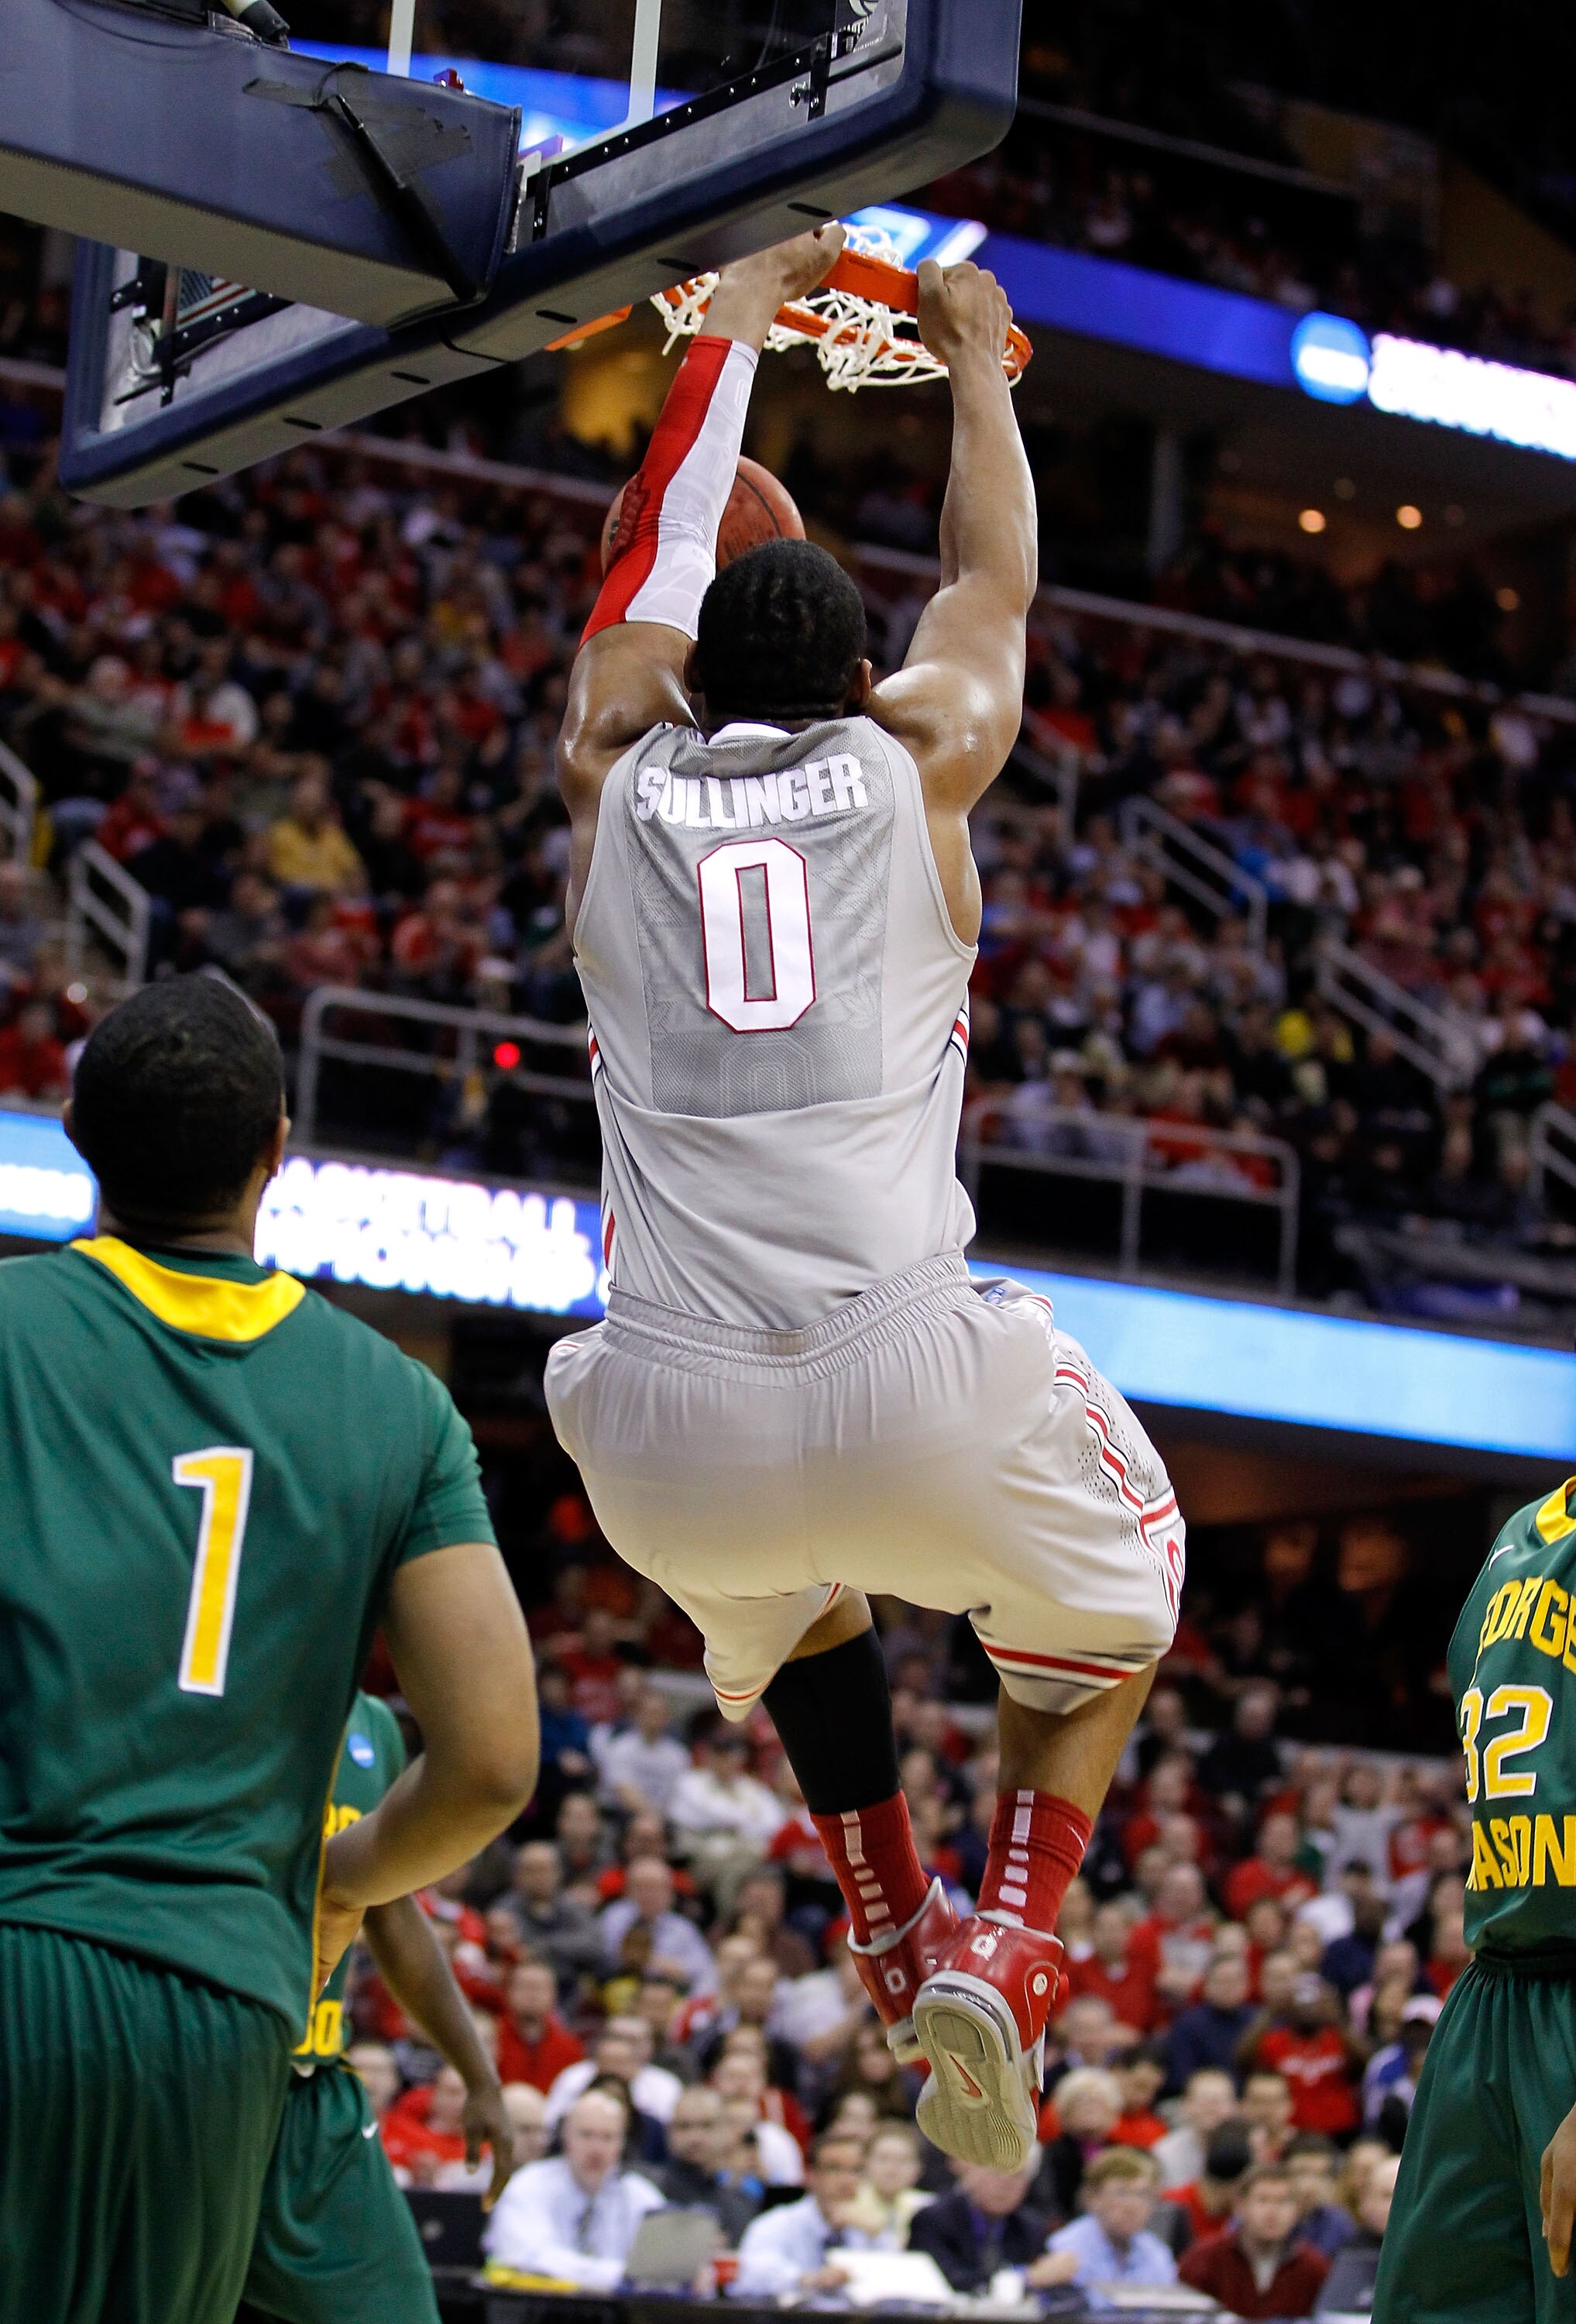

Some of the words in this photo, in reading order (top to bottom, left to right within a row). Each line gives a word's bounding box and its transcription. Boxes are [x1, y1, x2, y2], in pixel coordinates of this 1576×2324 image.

[637, 753, 868, 828] SULLINGER
[697, 837, 816, 1034] 0
[172, 1446, 253, 1697] 1
[1460, 1684, 1553, 1805] 32
[1465, 1813, 1576, 1892] ASON
